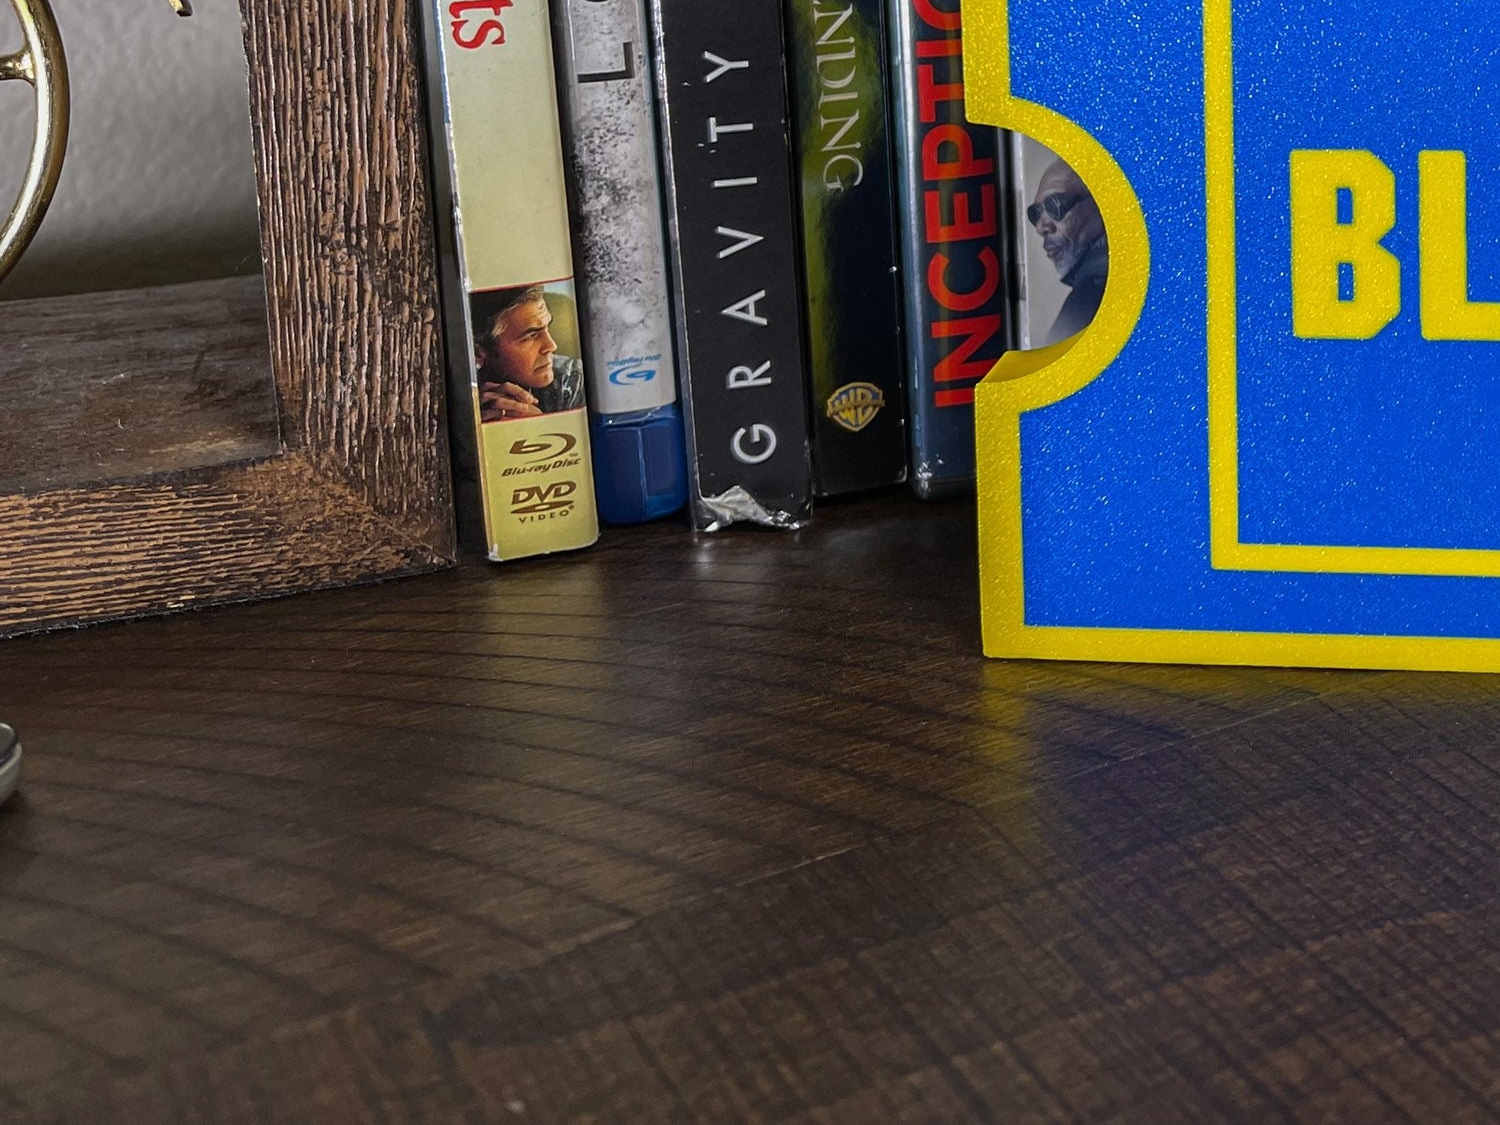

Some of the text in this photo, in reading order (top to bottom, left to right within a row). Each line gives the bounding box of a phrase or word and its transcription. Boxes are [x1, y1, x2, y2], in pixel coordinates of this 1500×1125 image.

[703, 51, 777, 465] GRAVITY
[551, 458, 581, 469] Disc
[511, 480, 577, 505] DVD
[519, 509, 569, 524] VIDEO
